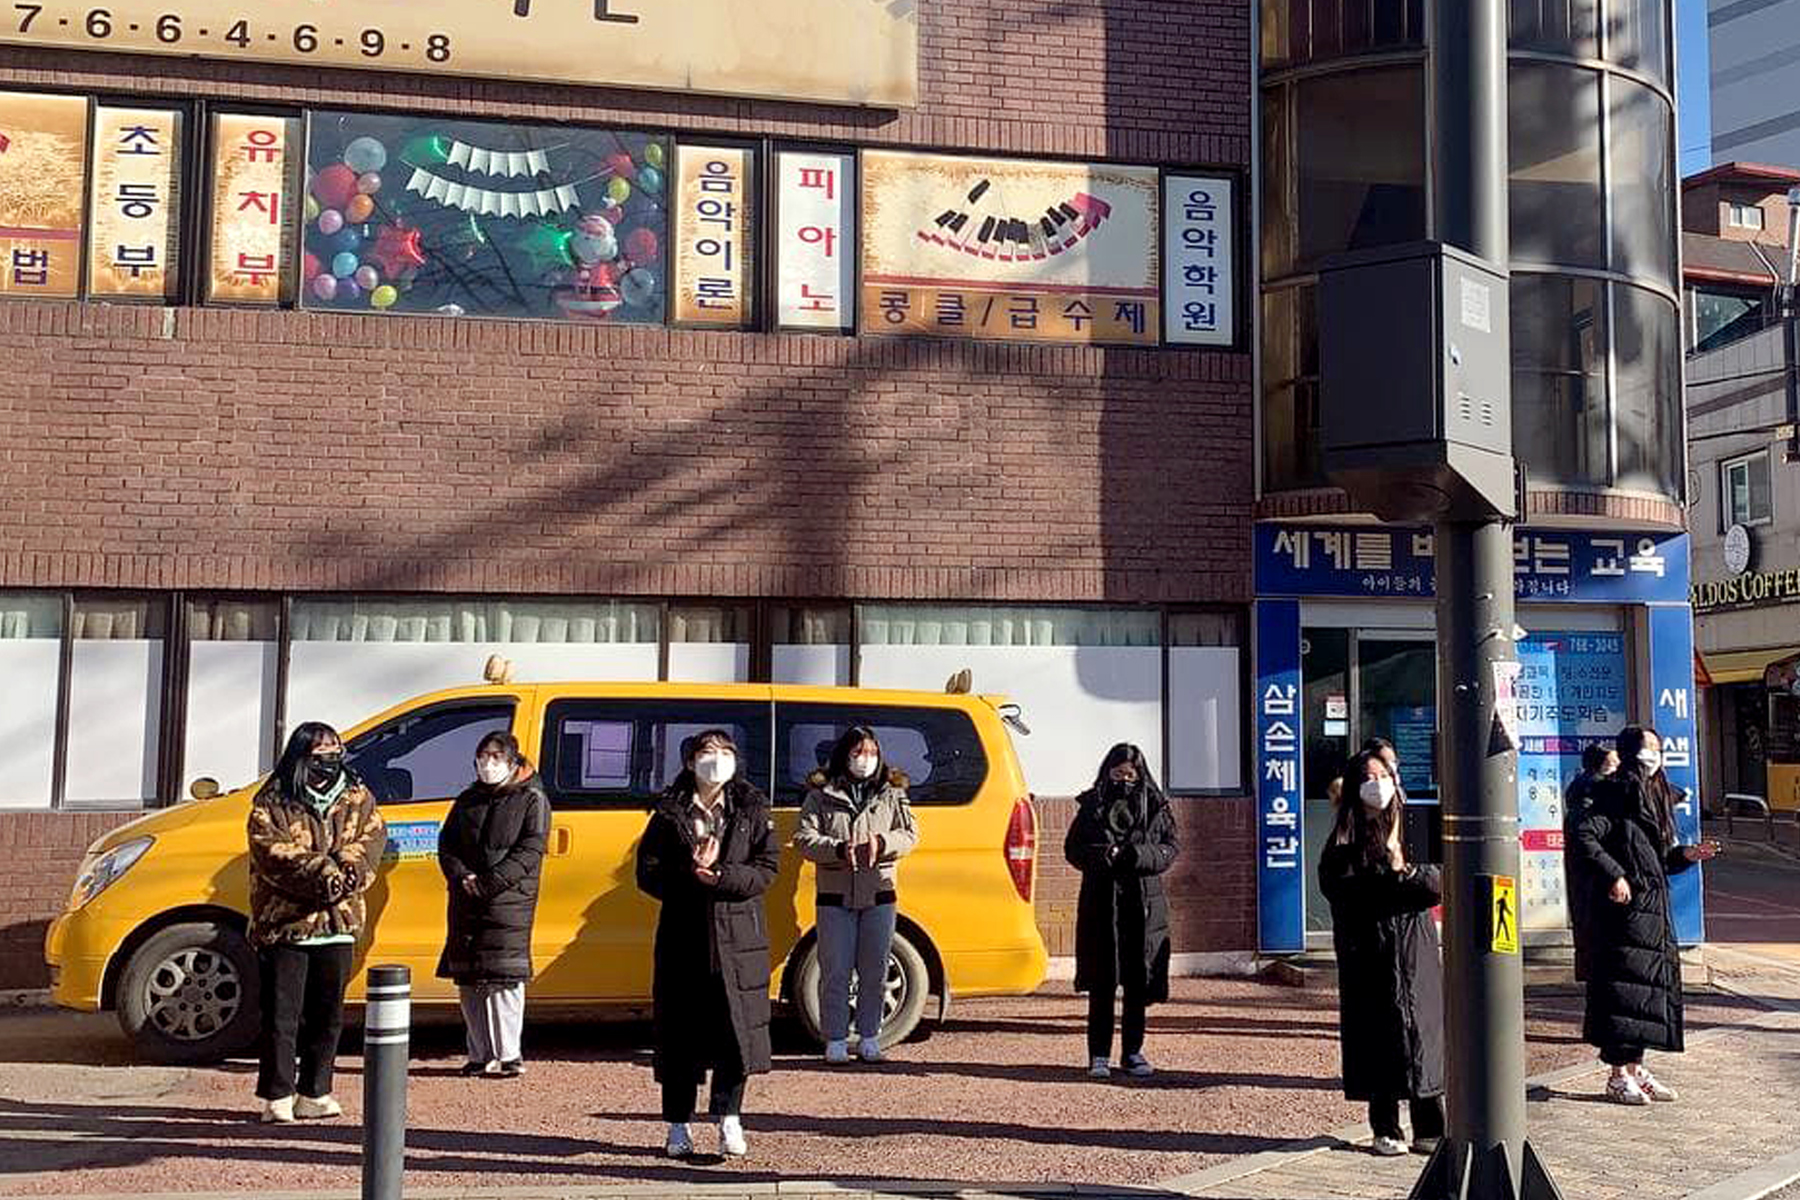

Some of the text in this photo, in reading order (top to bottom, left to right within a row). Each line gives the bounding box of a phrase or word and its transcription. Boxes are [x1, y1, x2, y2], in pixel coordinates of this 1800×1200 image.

[114, 124, 160, 277] 초등부
[236, 129, 279, 285] 유치부
[696, 159, 737, 310] 음악이론
[798, 166, 837, 312] 피아노
[1181, 189, 1217, 332] 음악학원
[1273, 530, 1392, 570] 세계를
[1590, 537, 1666, 578] 교육
[1741, 569, 1800, 600] COFFE
[1264, 683, 1299, 868] 삼손체육관
[1659, 688, 1691, 845] 새샘
